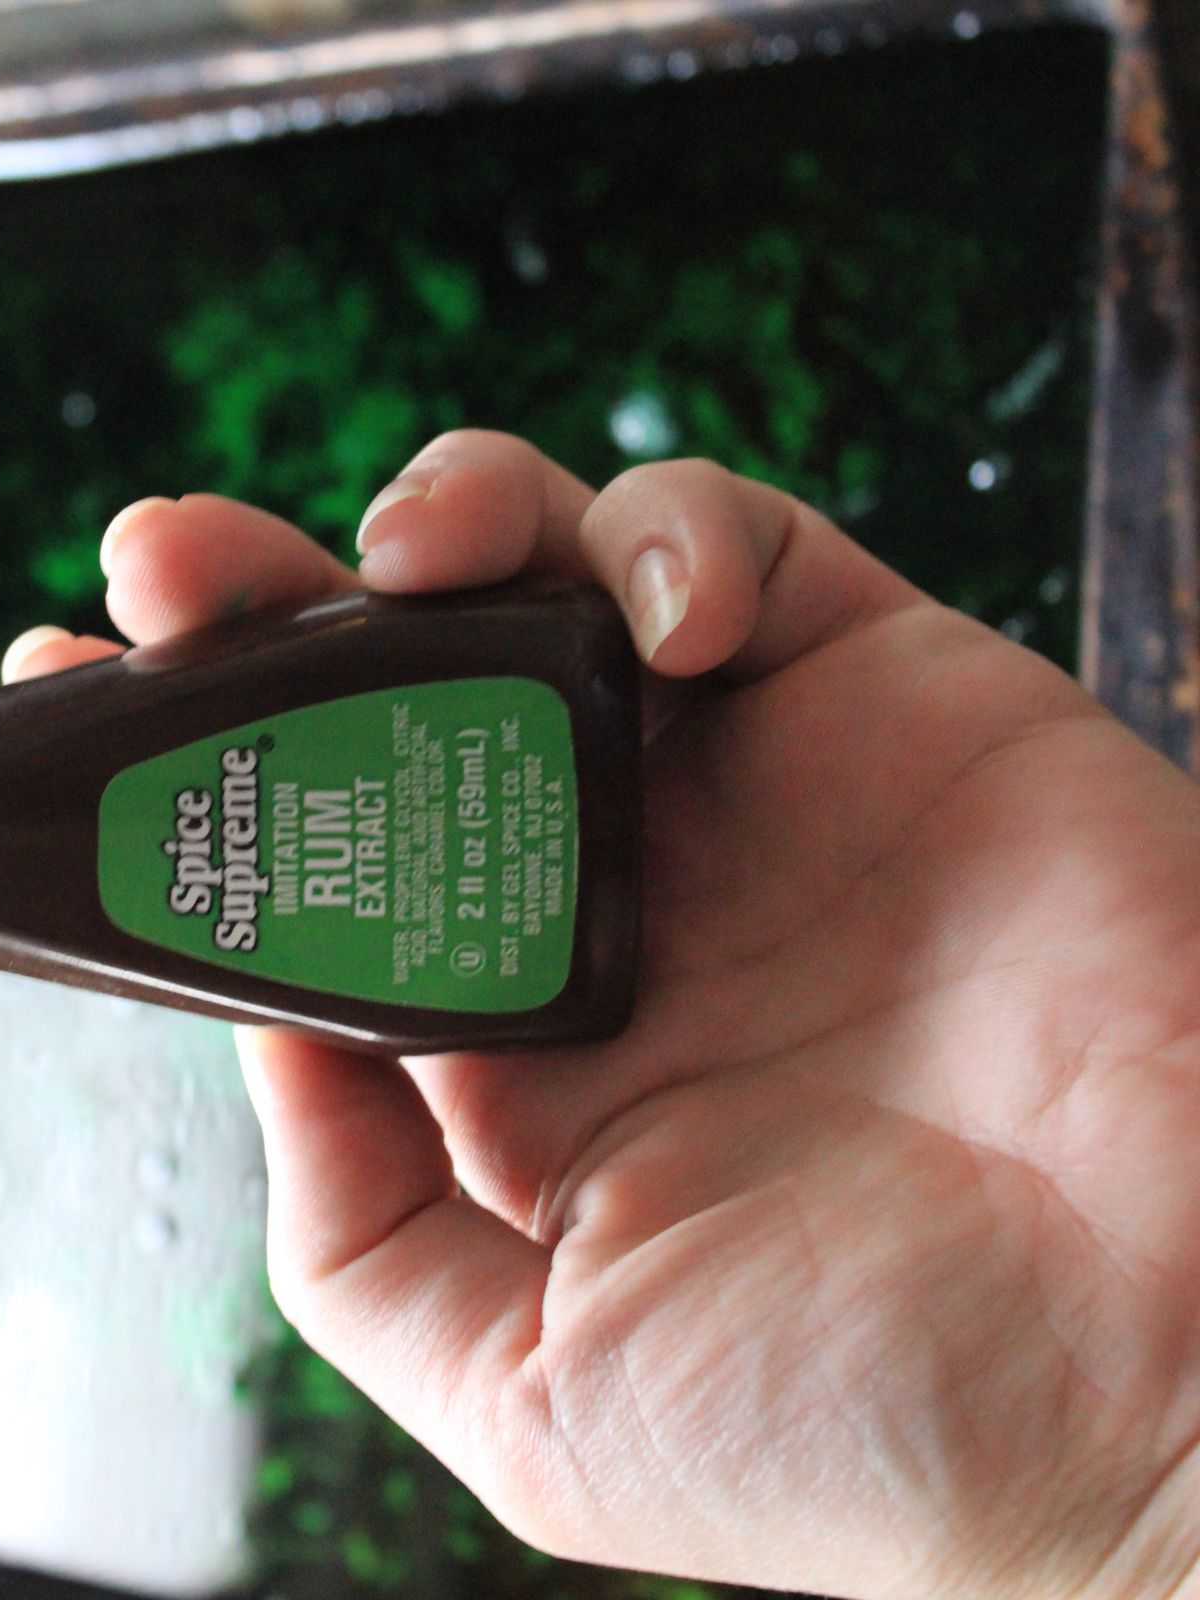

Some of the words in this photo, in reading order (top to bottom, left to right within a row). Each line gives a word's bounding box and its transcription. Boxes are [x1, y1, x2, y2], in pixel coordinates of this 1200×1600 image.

[456, 728, 492, 829] (59mL)
[162, 790, 223, 914] Spice
[213, 748, 270, 951] Supreme
[272, 782, 300, 915] IMITATION
[303, 789, 353, 907] RUM
[354, 776, 387, 918] EXTRACT
[462, 836, 486, 868] oz
[501, 802, 521, 856] SPICE
[523, 813, 544, 839] NJ
[545, 837, 564, 860] IN
[456, 875, 486, 895] fl
[501, 862, 520, 896] GEL
[544, 864, 564, 916] MADE
[456, 902, 486, 920] 2
[501, 899, 520, 924] BY
